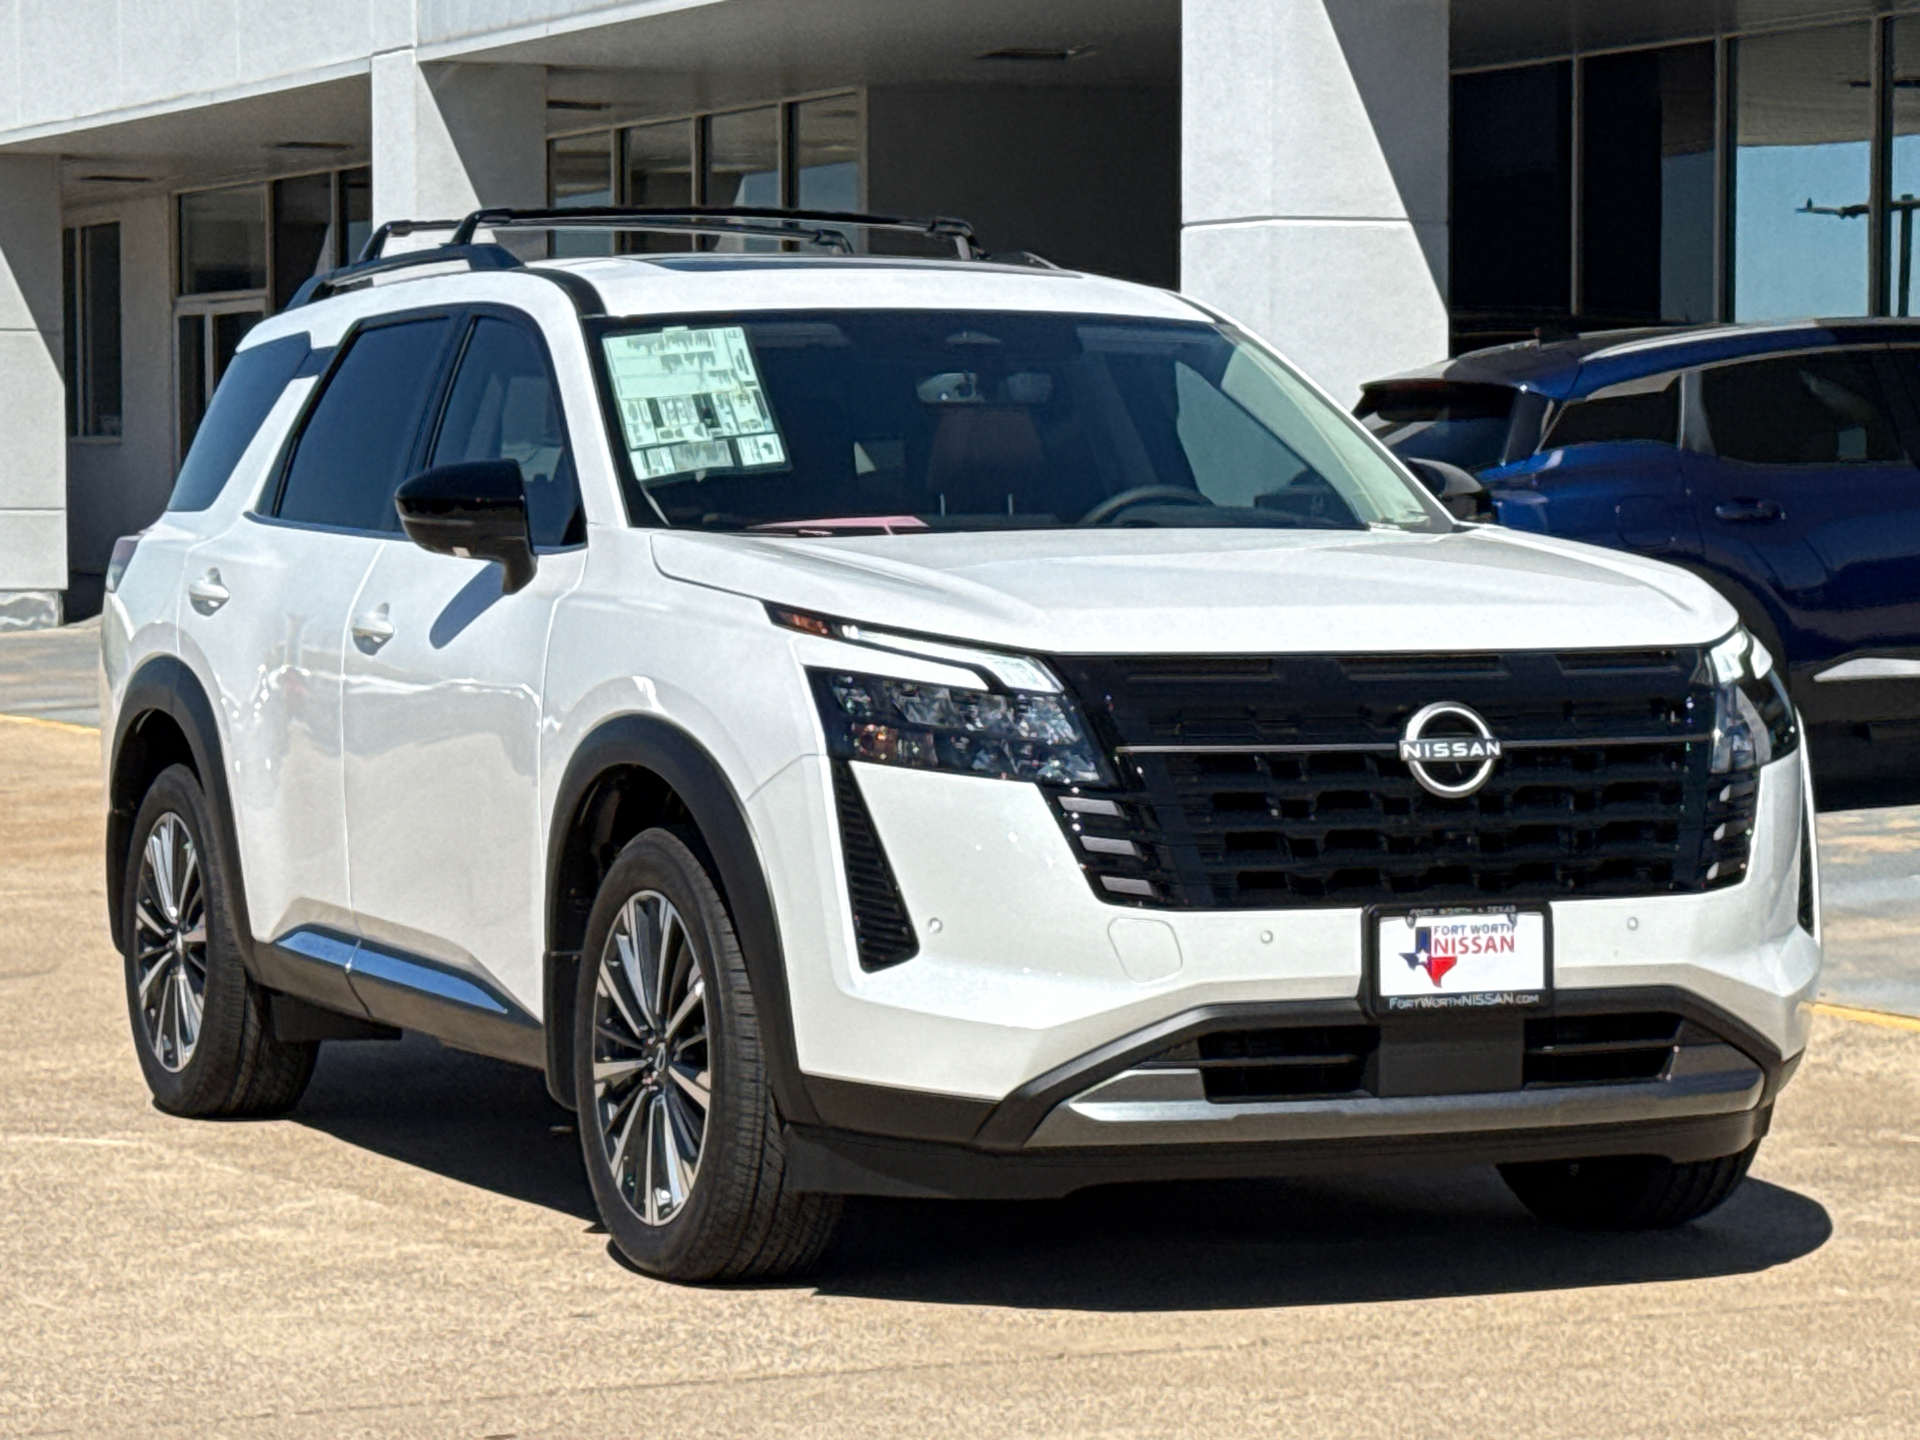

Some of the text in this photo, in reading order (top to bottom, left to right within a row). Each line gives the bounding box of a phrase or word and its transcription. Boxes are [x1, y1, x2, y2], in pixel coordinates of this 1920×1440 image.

[1403, 741, 1501, 759] NISSAN
[1487, 905, 1517, 914] TEXAS
[1434, 923, 1515, 936] FORT WORTH
[1434, 935, 1515, 955] NISSAN
